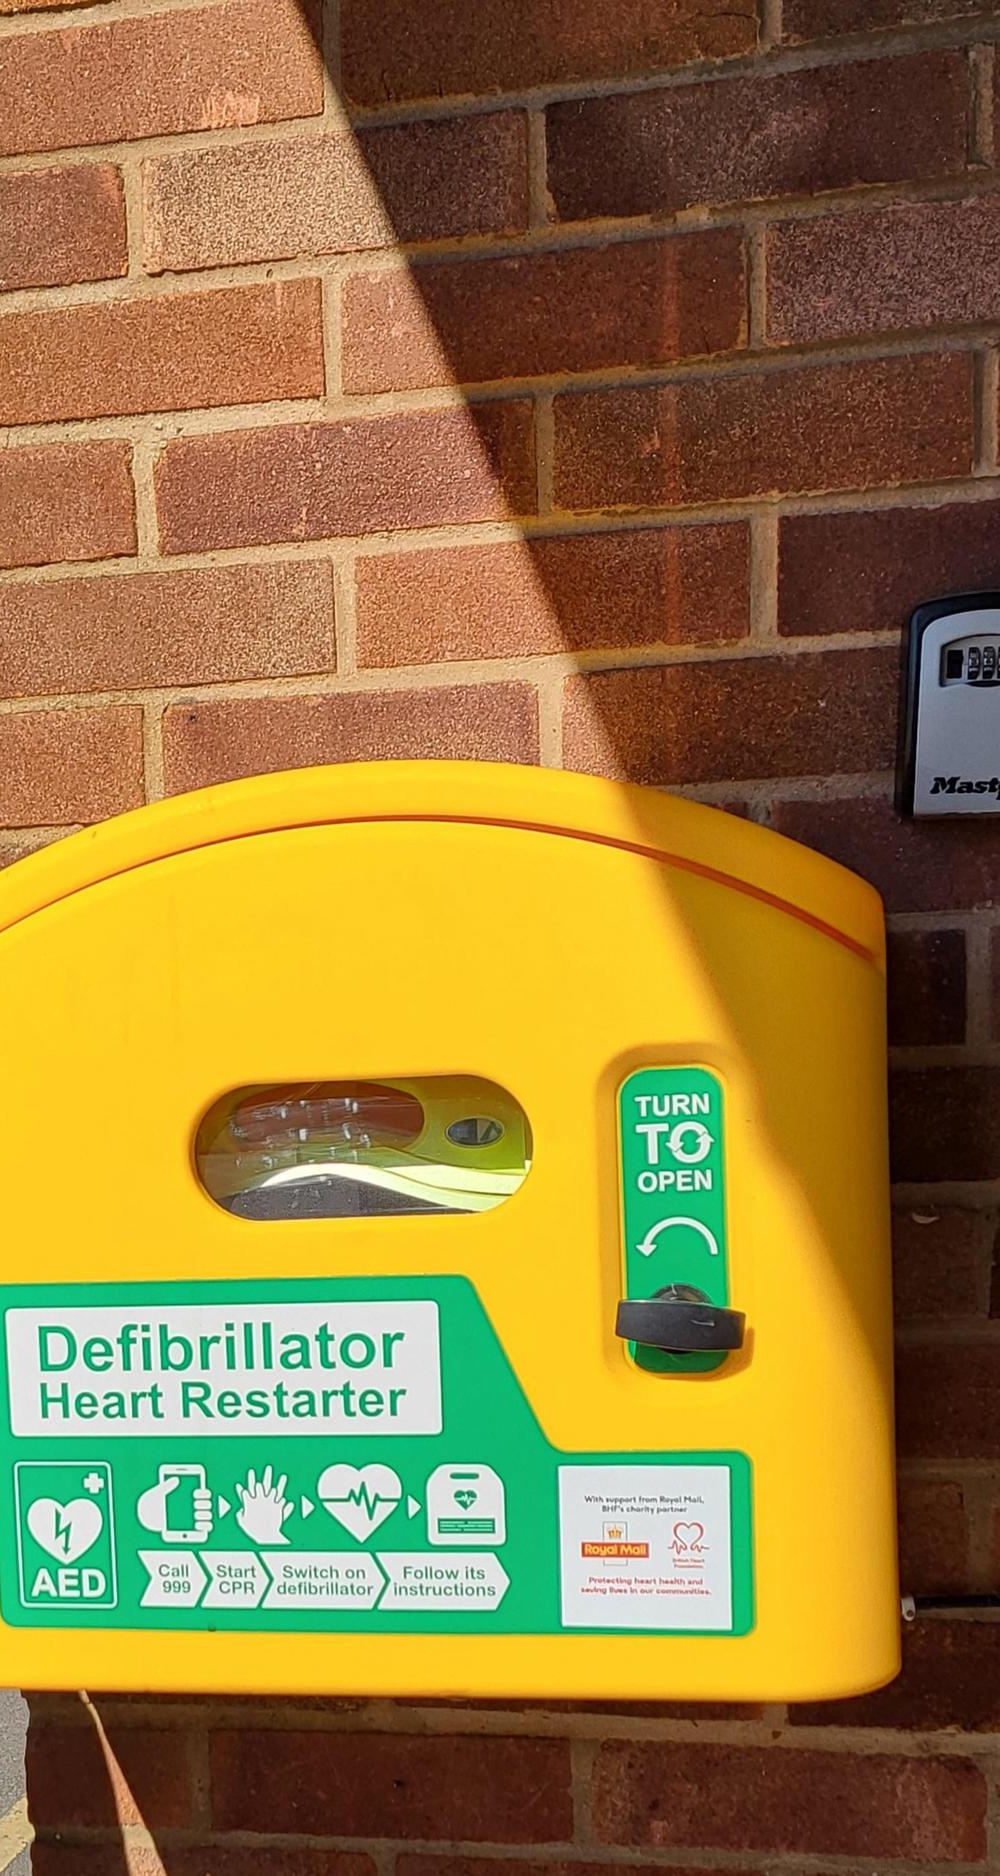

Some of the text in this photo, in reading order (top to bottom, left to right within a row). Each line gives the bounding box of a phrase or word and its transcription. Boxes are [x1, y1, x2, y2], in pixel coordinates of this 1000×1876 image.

[930, 776, 1000, 800] Mast
[634, 1093, 710, 1117] TURN
[635, 1121, 715, 1164] TO
[637, 1169, 712, 1193] OPEN
[37, 1322, 406, 1372] Defibrillator
[39, 1381, 407, 1419] Heart Restarter
[584, 1495, 604, 1503] With
[605, 1495, 637, 1504] support
[638, 1495, 658, 1503] from
[659, 1495, 682, 1505] Royal
[626, 1505, 655, 1514] charity
[656, 1506, 688, 1515] partner
[584, 1544, 647, 1556] Royal Mail
[158, 1564, 189, 1578] Call
[216, 1564, 257, 1579] Start
[282, 1564, 366, 1579] Switch on
[403, 1566, 486, 1580] Follow its
[31, 1567, 107, 1599] AED
[162, 1580, 192, 1594] 999
[218, 1581, 256, 1595] CPR
[276, 1581, 374, 1596] defibrillator
[588, 1577, 632, 1586] Protecting
[634, 1577, 657, 1585] heart
[659, 1577, 686, 1586] health
[393, 1582, 497, 1597] instructions
[581, 1586, 607, 1595] saving
[609, 1586, 628, 1594] lives
